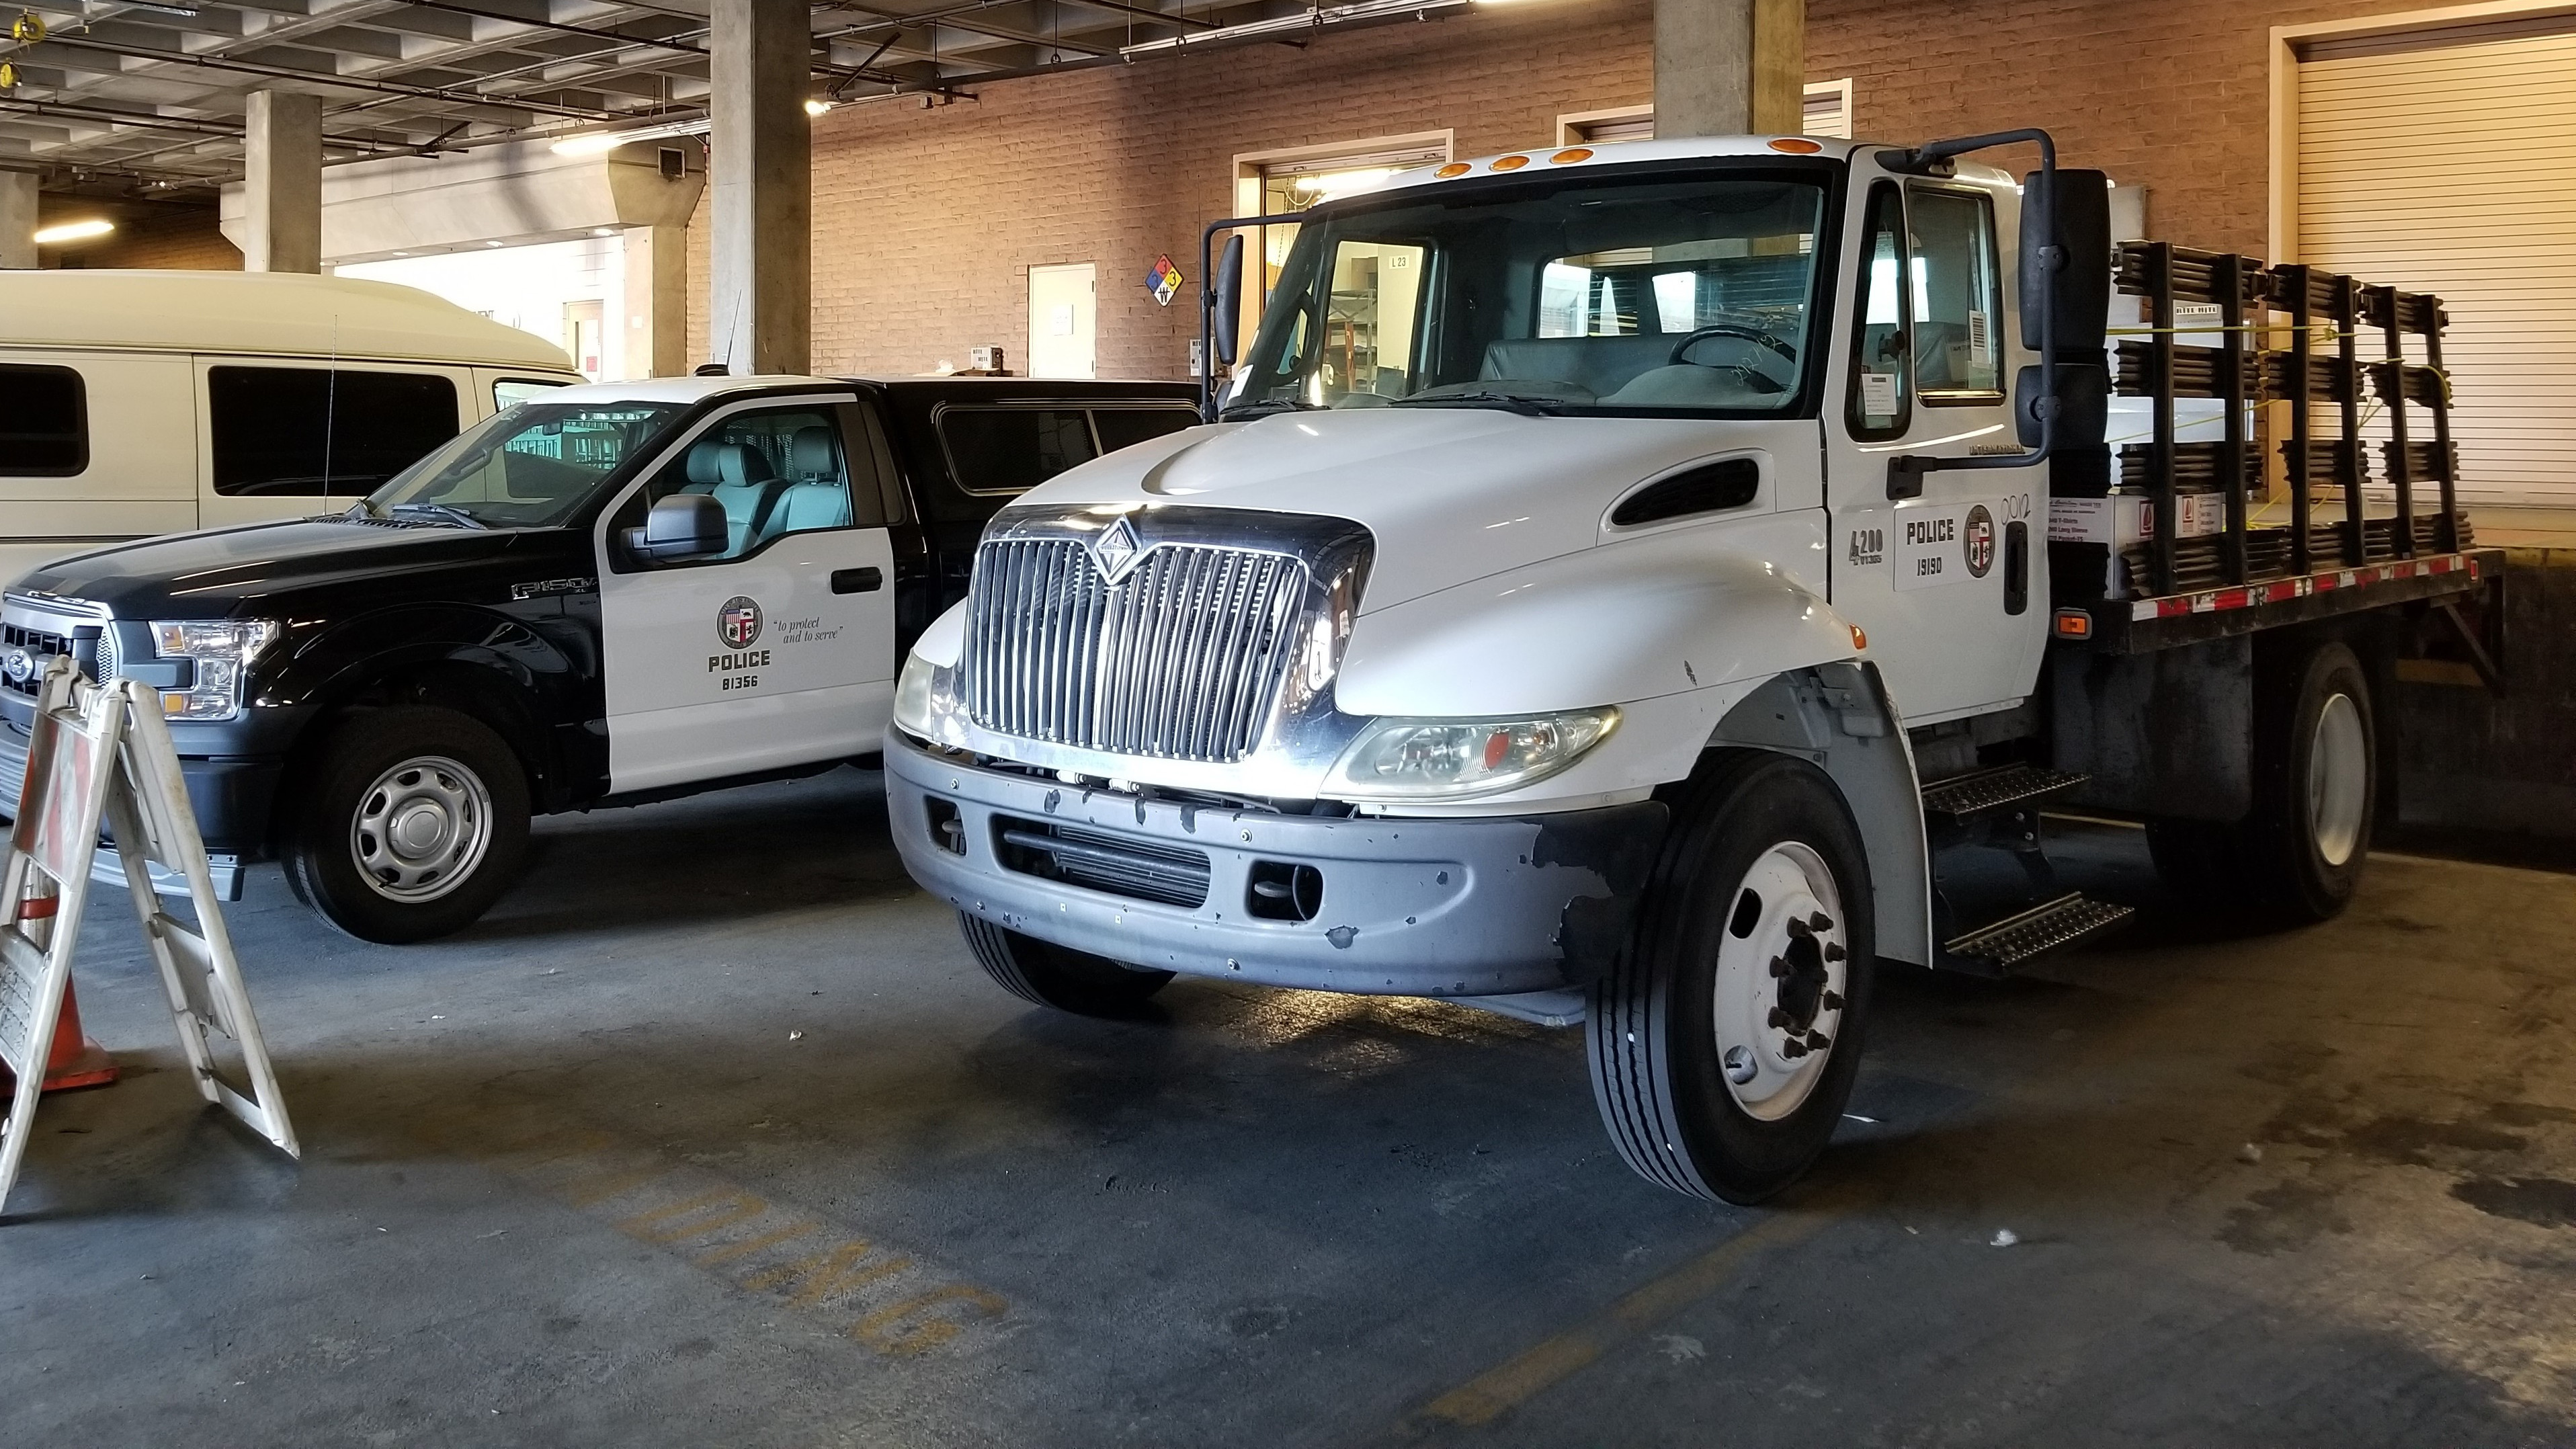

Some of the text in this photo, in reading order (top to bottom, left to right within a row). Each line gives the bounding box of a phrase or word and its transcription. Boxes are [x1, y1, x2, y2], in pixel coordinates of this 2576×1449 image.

[1160, 259, 1167, 274] 3
[1392, 257, 1406, 267] L 23
[1151, 271, 1176, 290] 3 3
[1906, 518, 1954, 545] POLICE
[1849, 529, 1883, 566] 4200
[788, 616, 820, 633] protect
[783, 630, 801, 644] and
[804, 628, 813, 642] to
[708, 649, 771, 673] POLICE
[722, 675, 758, 691] 81356
